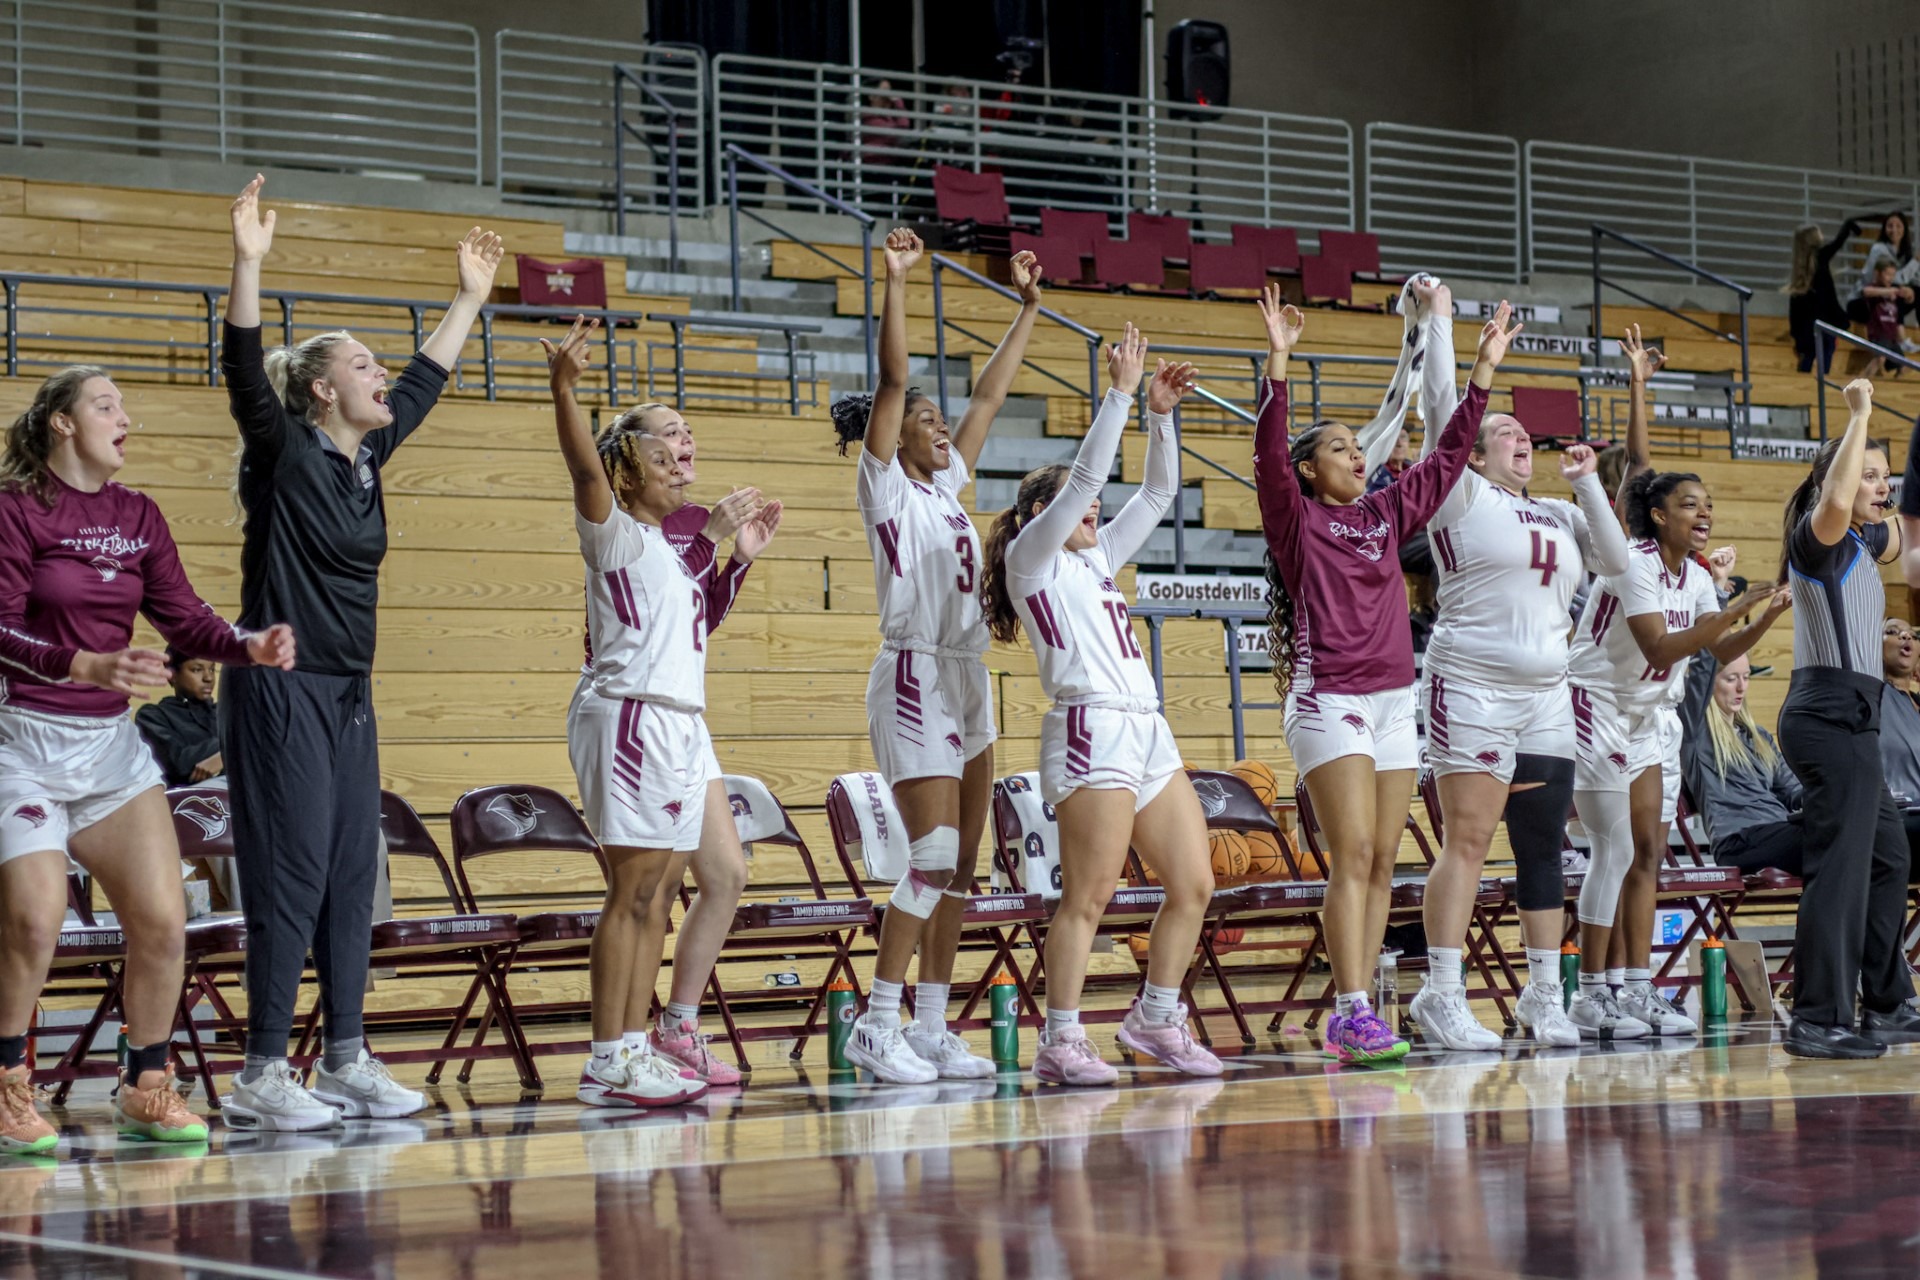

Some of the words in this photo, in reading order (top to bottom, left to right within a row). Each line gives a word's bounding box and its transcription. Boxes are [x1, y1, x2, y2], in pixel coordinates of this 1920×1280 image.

[1480, 302, 1536, 321] FIHT!
[1510, 336, 1599, 355] STDEVILS
[955, 535, 975, 594] 3
[1529, 530, 1560, 587] 4
[691, 588, 706, 653] 2
[1102, 599, 1142, 660] 12
[1116, 894, 1135, 905] TAMIU
[1302, 888, 1325, 898] DUSTDE
[792, 906, 812, 917] TAMIU
[813, 904, 850, 916] DUSTDEVILS
[975, 900, 993, 912] TAMIU
[994, 899, 1025, 911] DUSTDEVILS
[430, 922, 451, 934] TAMIU
[452, 920, 490, 933] DUSTDEVILS
[58, 934, 80, 946] TAMIU
[80, 932, 123, 945] DUSTDEVILS
